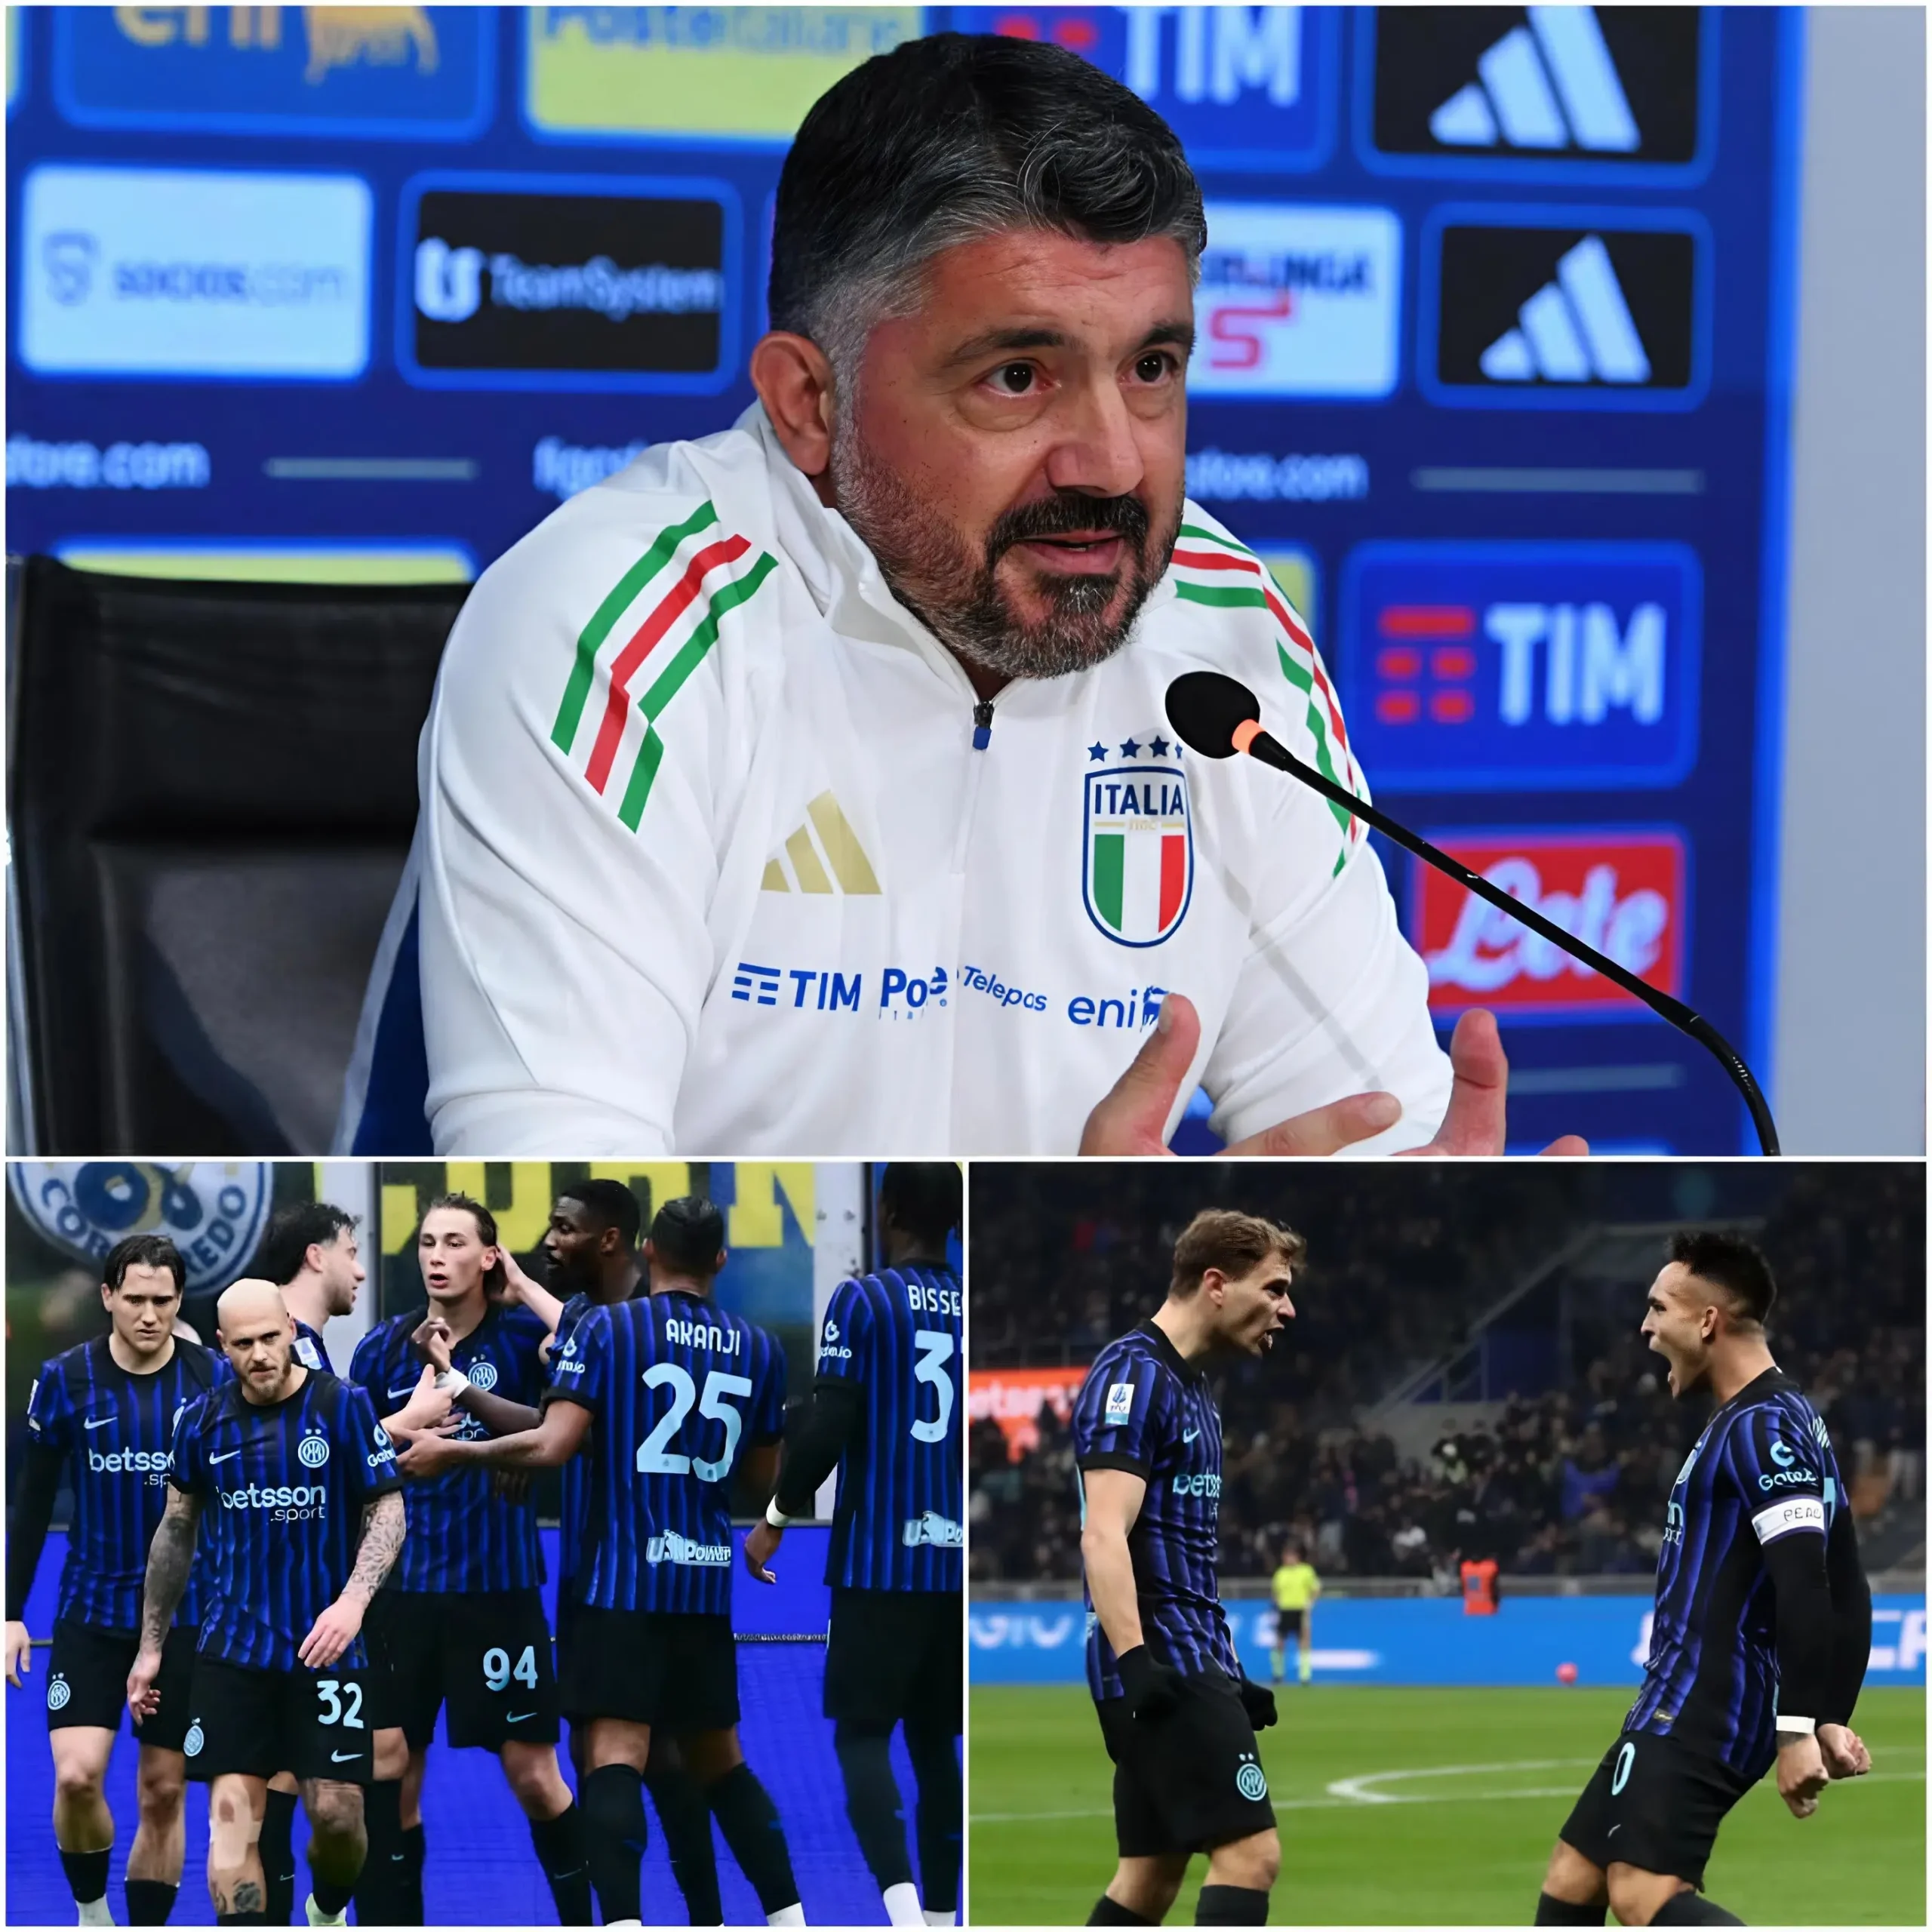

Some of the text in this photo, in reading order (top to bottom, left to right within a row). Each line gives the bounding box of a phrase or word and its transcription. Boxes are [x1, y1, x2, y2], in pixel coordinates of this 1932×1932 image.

[1115, 6, 1301, 106] TIM
[490, 254, 720, 320] TeamSystem
[6, 432, 210, 488] tore.com
[1484, 602, 1666, 726] TIM
[1094, 783, 1185, 815] ITALIA
[789, 970, 861, 1011] TIM
[1067, 989, 1137, 1028] eni
[907, 1284, 962, 1316] BISSE
[666, 1318, 740, 1356] AKANJI
[910, 1329, 962, 1443] 3
[636, 1363, 752, 1483] 25
[216, 1482, 325, 1509] betsson
[483, 1645, 538, 1691] 94
[317, 1679, 364, 1729] 32
